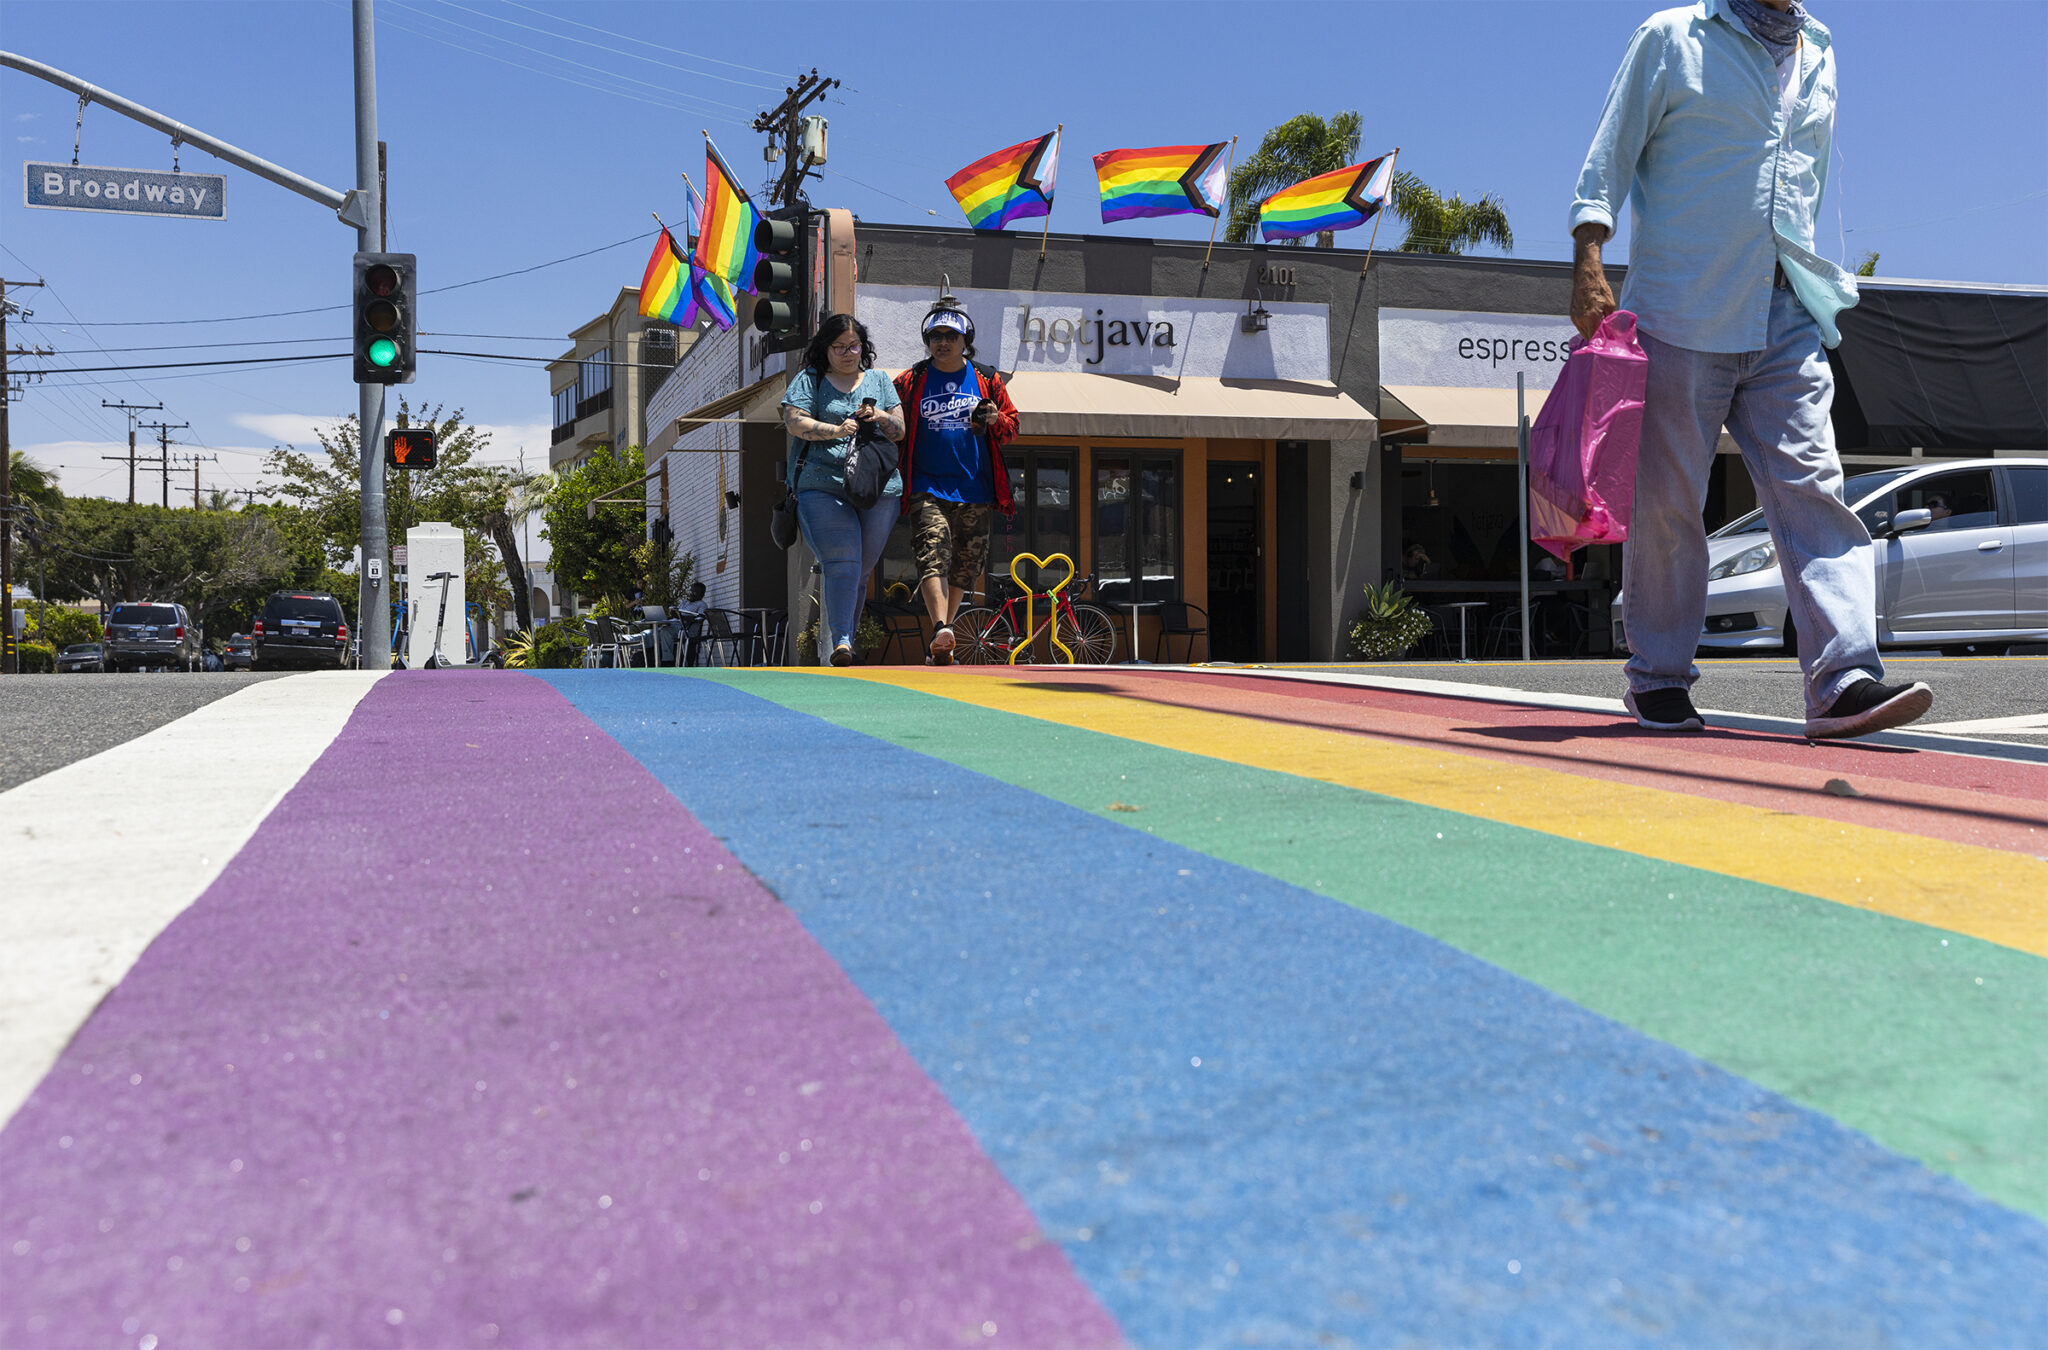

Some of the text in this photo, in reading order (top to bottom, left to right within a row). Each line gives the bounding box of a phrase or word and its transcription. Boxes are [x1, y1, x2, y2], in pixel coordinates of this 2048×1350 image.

[44, 172, 207, 210] Broadway
[1257, 266, 1297, 286] 2101
[1020, 304, 1177, 364] hotjava
[1458, 338, 1569, 368] espress
[922, 395, 981, 418] Dodgers
